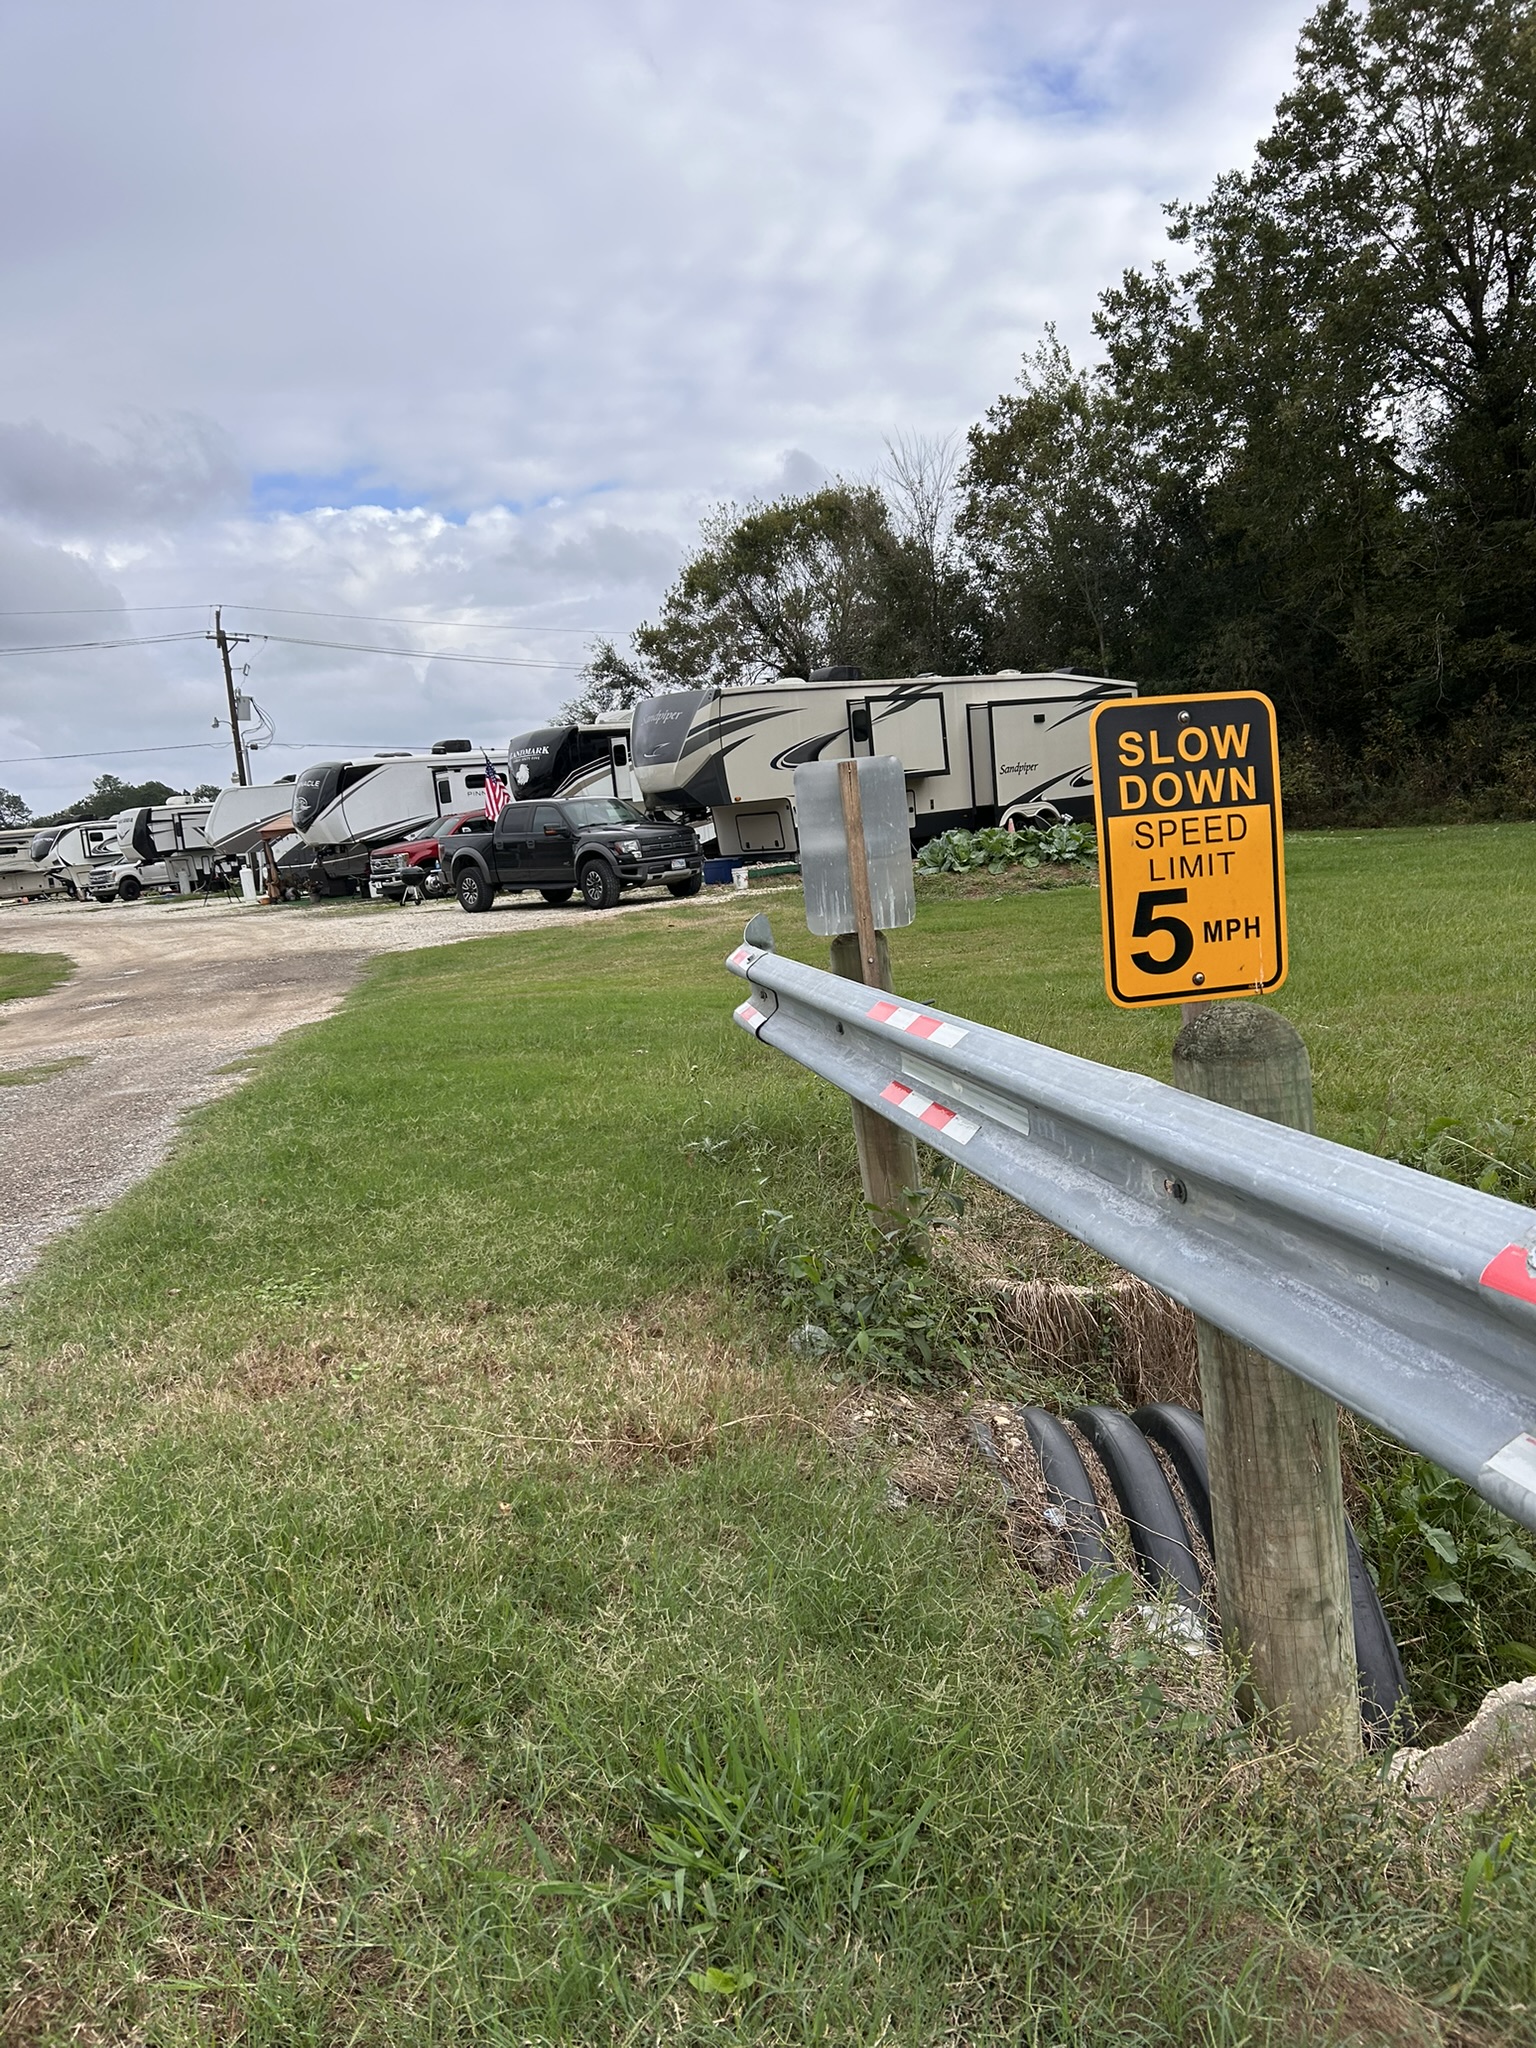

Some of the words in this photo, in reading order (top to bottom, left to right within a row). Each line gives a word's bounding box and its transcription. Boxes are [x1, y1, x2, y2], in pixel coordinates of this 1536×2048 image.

[511, 745, 550, 760] LANDMARK
[1117, 723, 1251, 767] SLOW
[999, 761, 1039, 776] Sandpiper
[1118, 765, 1257, 811] DOWN
[1135, 813, 1247, 850] SPEED
[1149, 851, 1236, 882] LIMIT
[1130, 887, 1195, 975] 5
[1203, 916, 1261, 943] MPH
